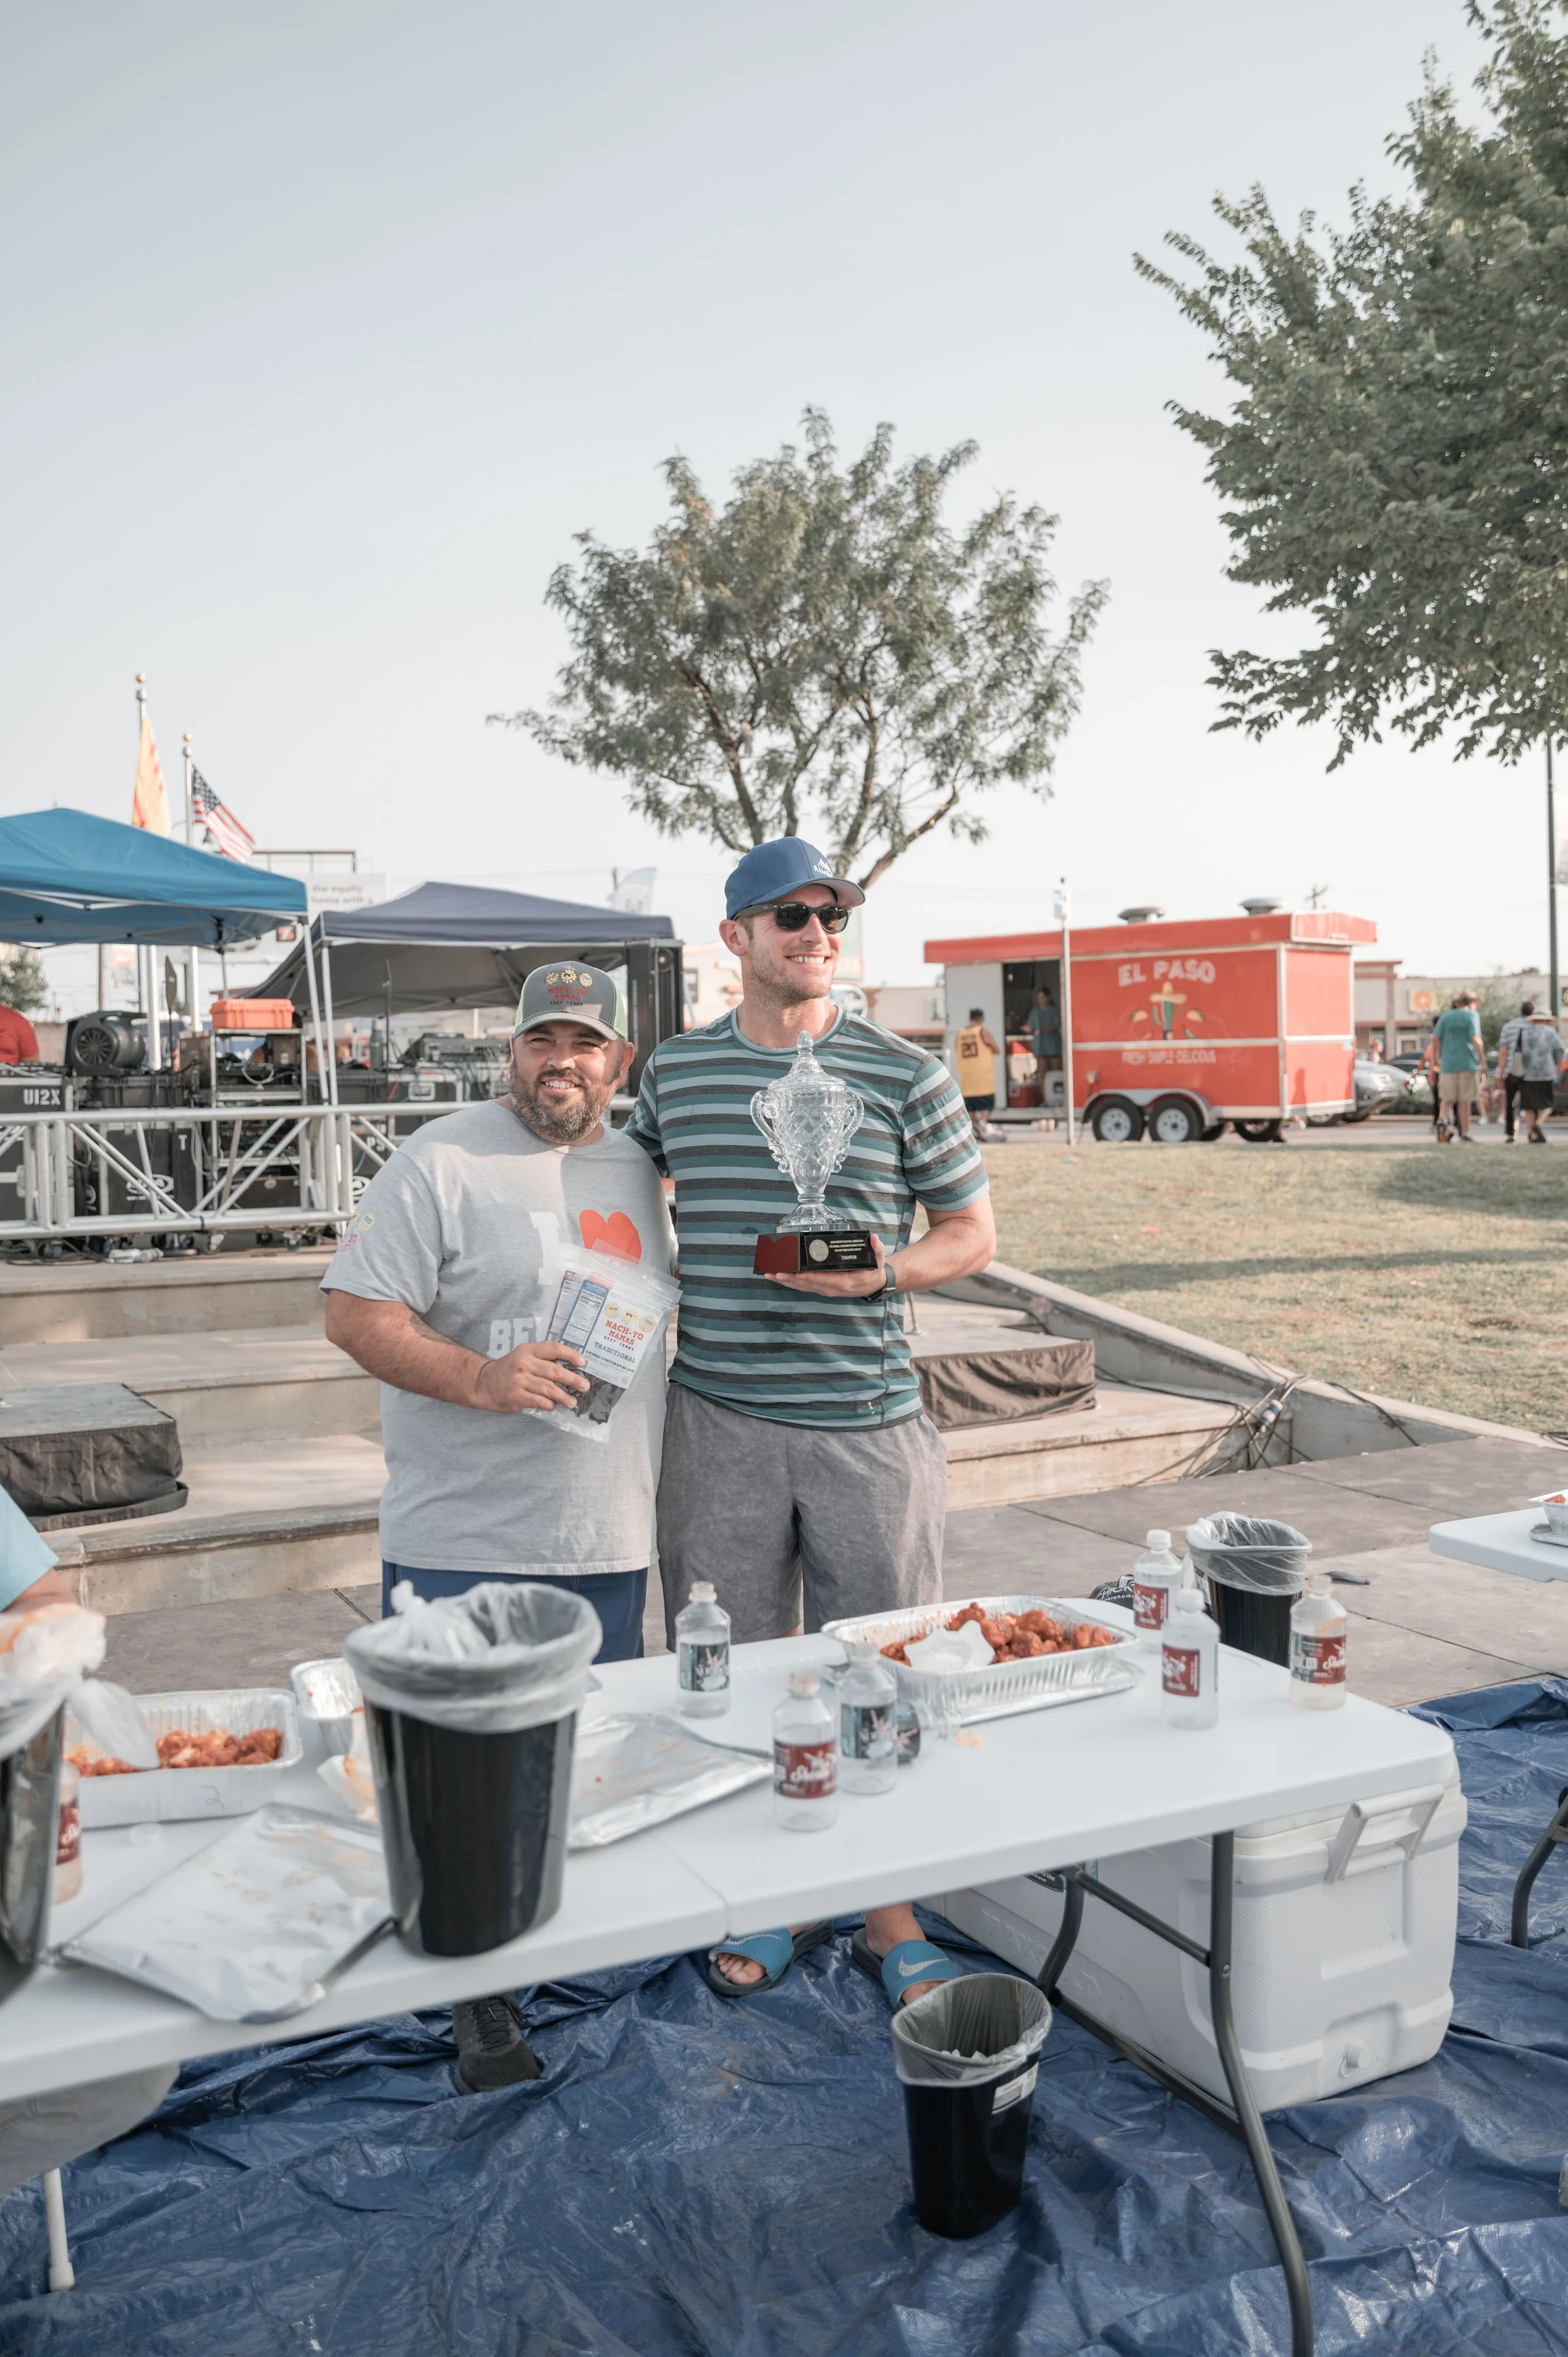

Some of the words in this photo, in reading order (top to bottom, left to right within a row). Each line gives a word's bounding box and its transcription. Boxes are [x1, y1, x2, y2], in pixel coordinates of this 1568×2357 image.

[1118, 962, 1147, 987] EL
[1153, 959, 1216, 984] PASO
[605, 1320, 644, 1340] NACH-YO
[608, 1330, 635, 1345] MAMAS
[594, 1342, 635, 1363] TRADITIONAL
